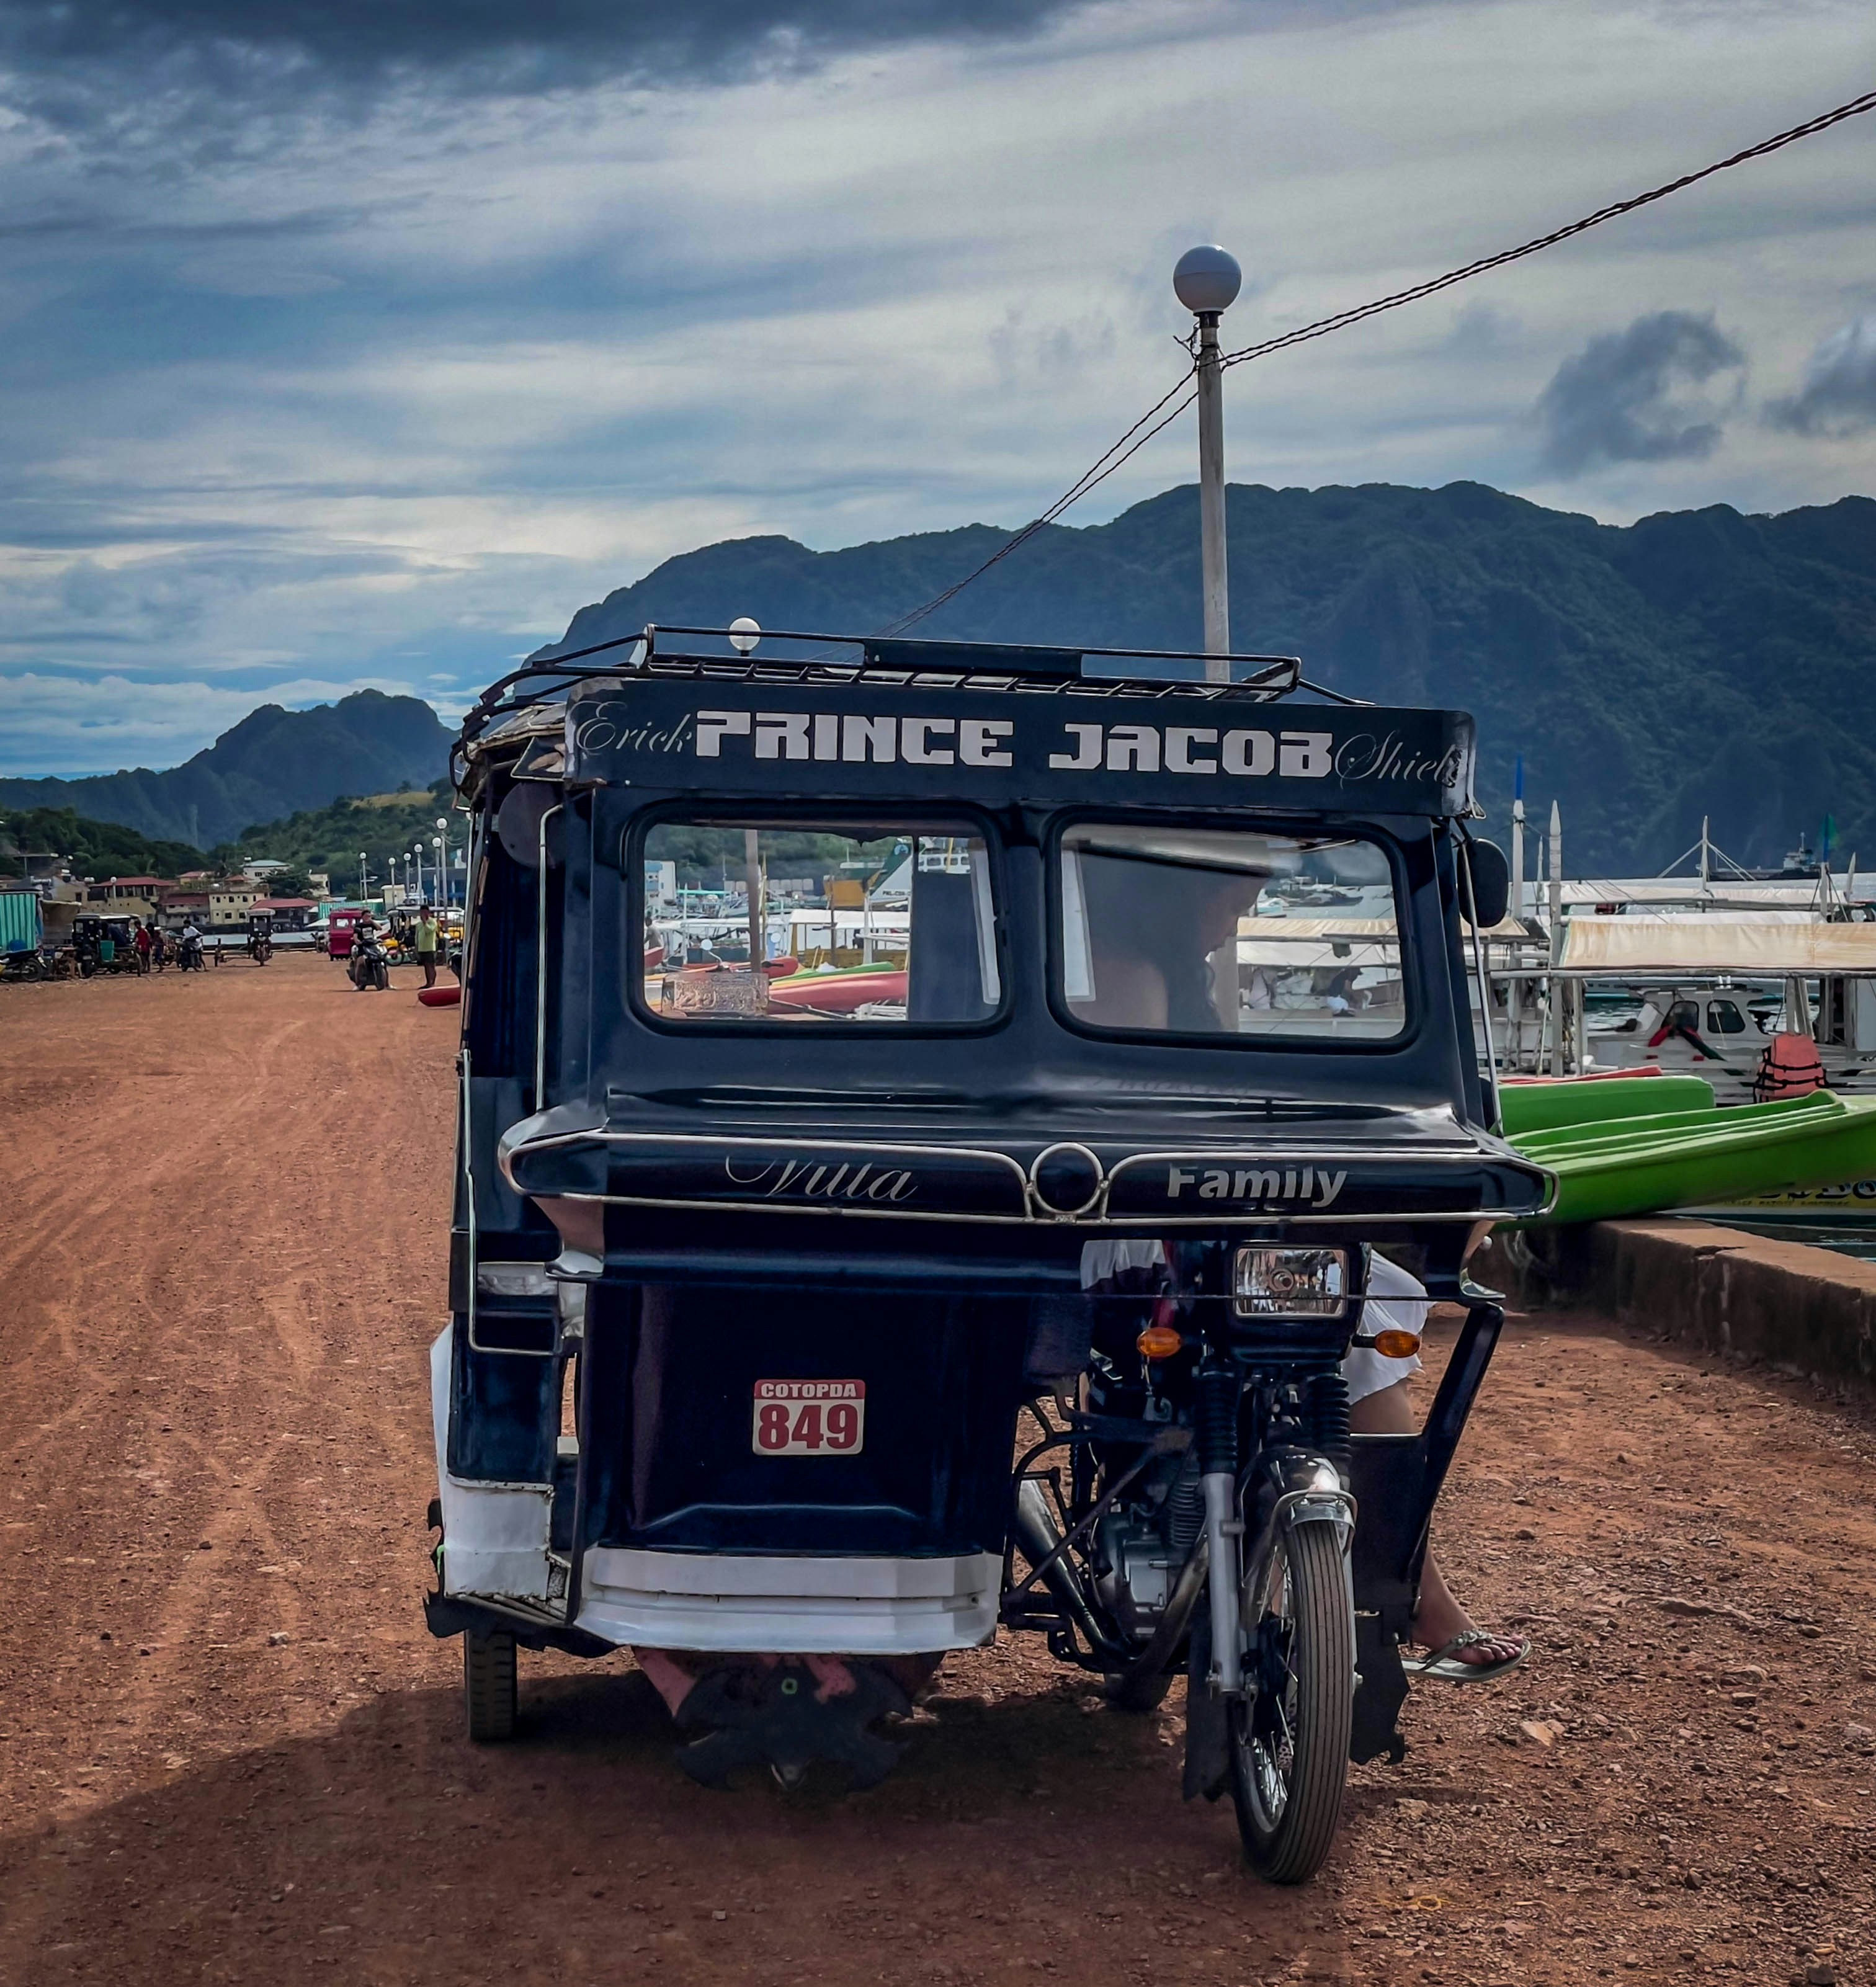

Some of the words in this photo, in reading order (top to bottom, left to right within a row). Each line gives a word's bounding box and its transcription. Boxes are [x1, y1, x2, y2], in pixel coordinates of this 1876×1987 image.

[569, 700, 692, 756] Erick
[695, 709, 1014, 767] PRINCE
[1048, 723, 1334, 778] JACOB
[725, 1156, 919, 1201] Villa
[1166, 1162, 1348, 1208] Family
[760, 1383, 857, 1398] COTOPDA
[757, 1403, 859, 1450] 849
